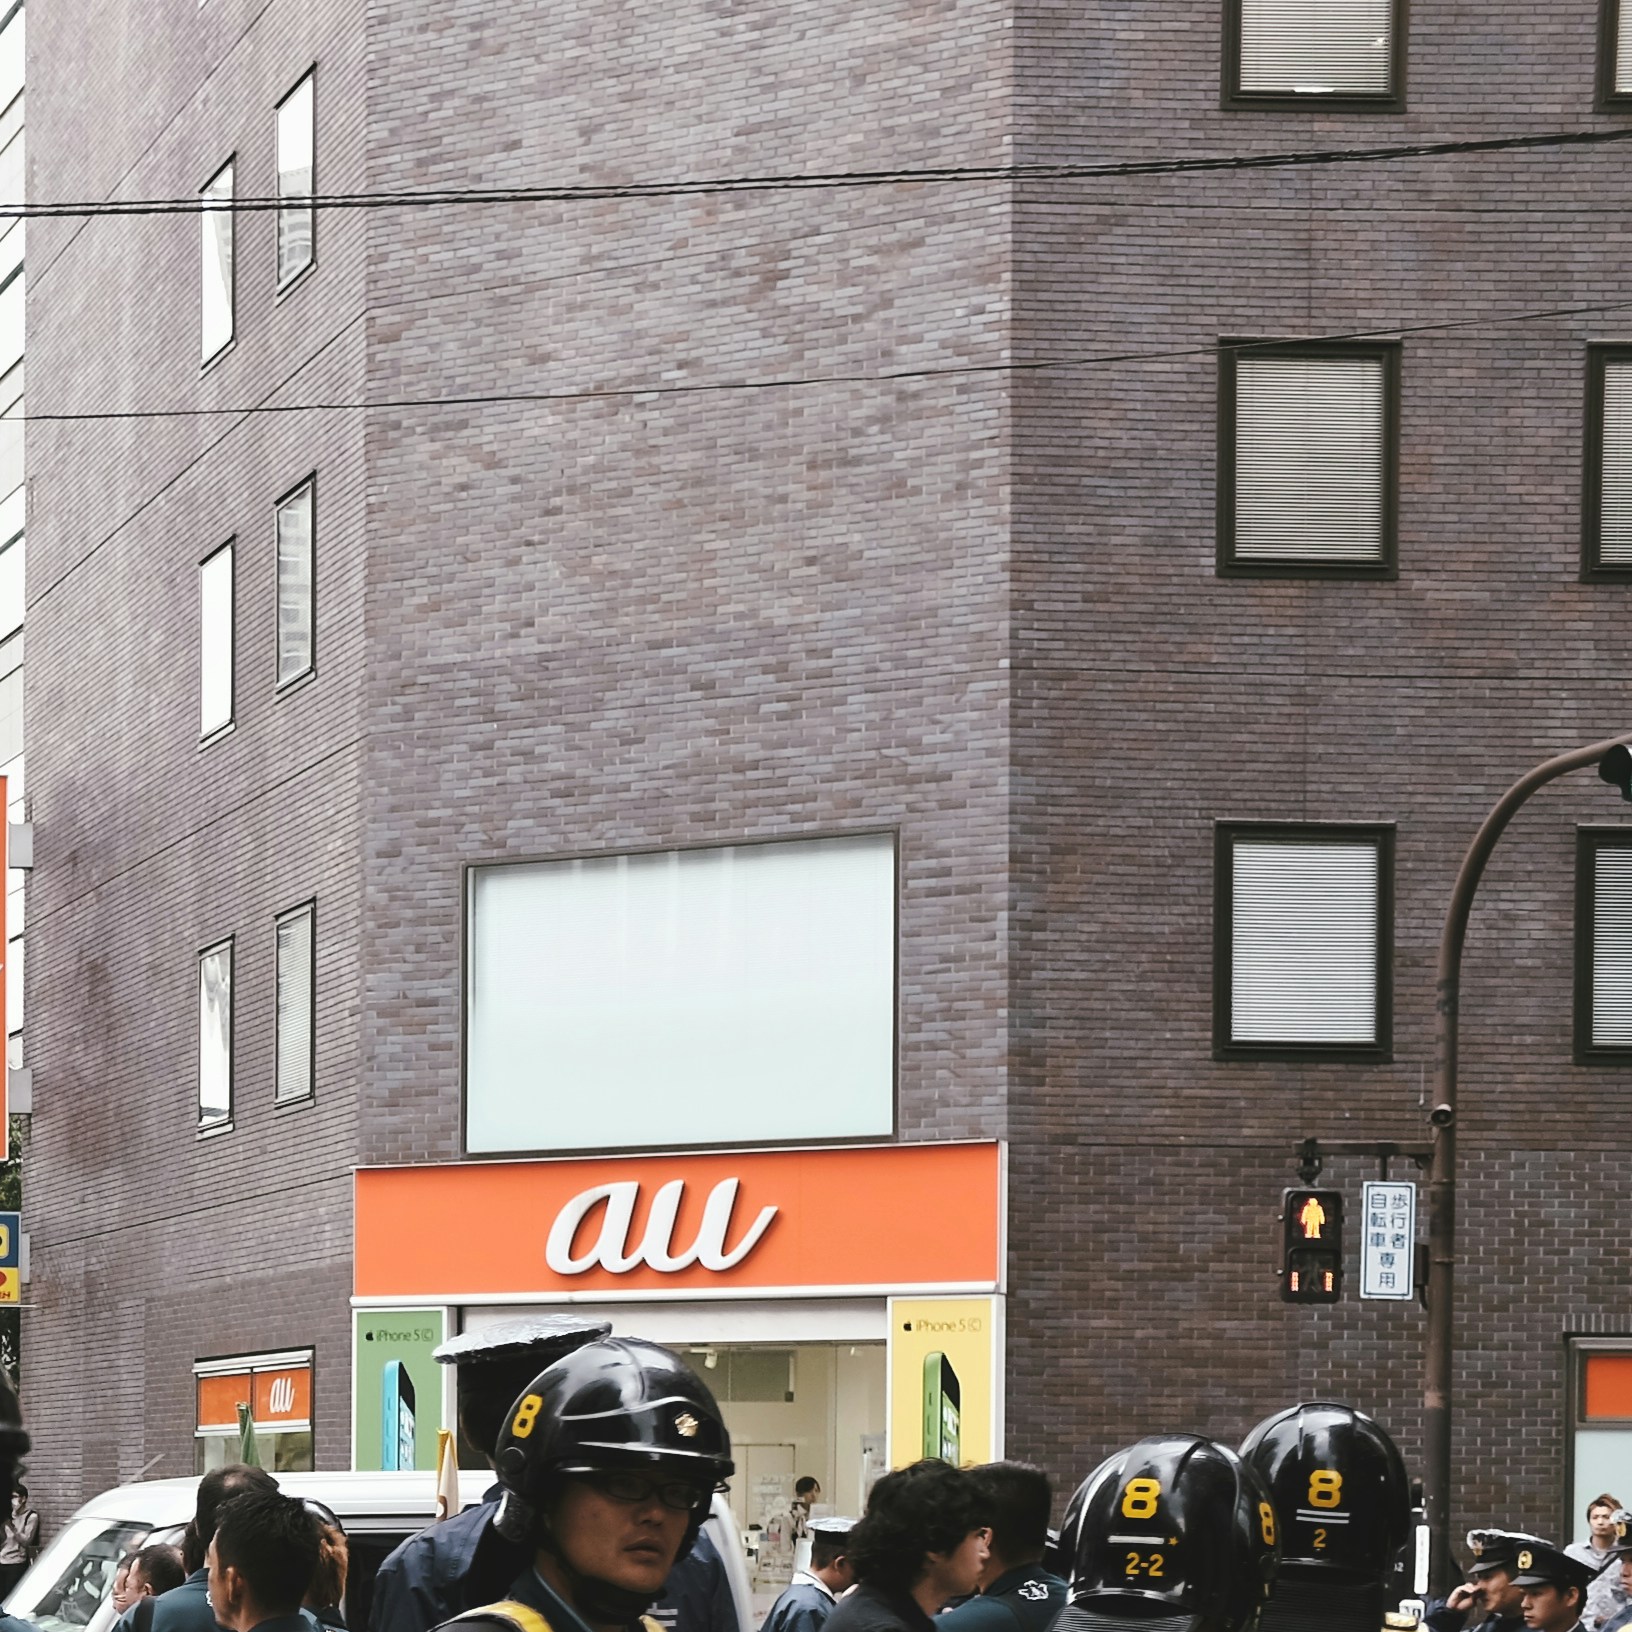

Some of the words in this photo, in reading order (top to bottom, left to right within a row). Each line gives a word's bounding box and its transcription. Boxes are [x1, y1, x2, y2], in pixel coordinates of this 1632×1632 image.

[545, 1176, 779, 1274] au
[1369, 1193, 1387, 1248] 自転車
[1390, 1193, 1408, 1249] 歩行者
[1379, 1252, 1395, 1289] 専用
[376, 1329, 412, 1342] iPhone
[916, 1319, 957, 1332] iPhone
[269, 1377, 295, 1413] au
[511, 1393, 544, 1439] 8
[1122, 1477, 1162, 1520] 8
[1307, 1468, 1343, 1509] 8
[1258, 1501, 1275, 1546] 8
[1313, 1528, 1327, 1548] 2
[1125, 1552, 1164, 1577] 2-2
